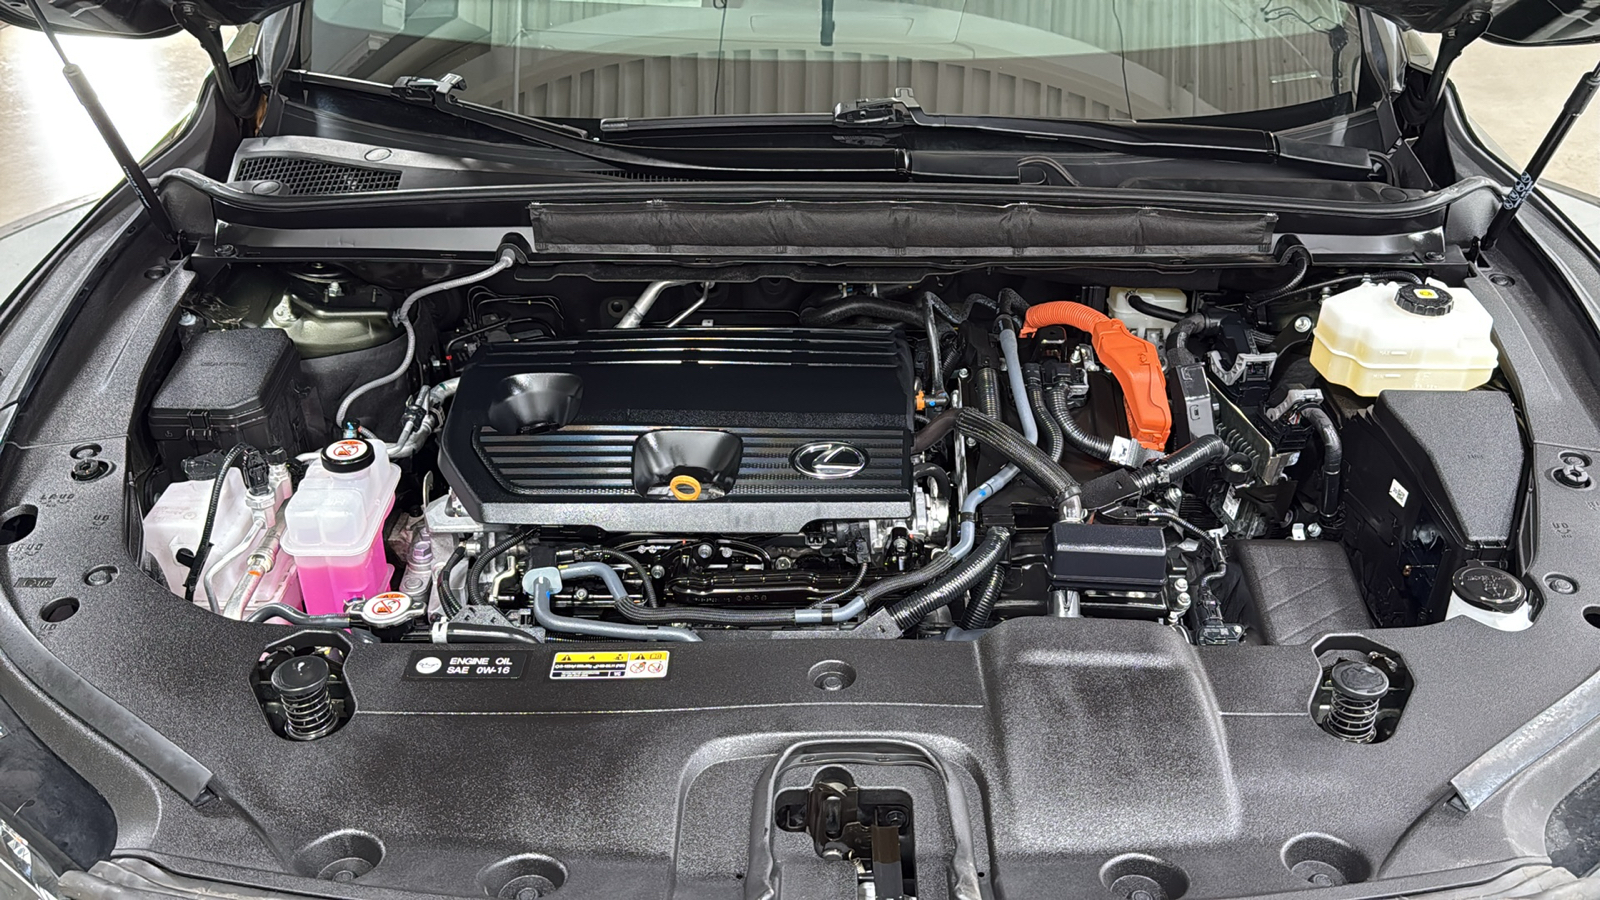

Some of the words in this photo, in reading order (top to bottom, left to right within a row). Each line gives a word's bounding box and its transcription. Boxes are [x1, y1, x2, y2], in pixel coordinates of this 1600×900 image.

[449, 657, 490, 665] ENGINE
[495, 657, 513, 665] OIL
[446, 666, 470, 674] SAE
[475, 666, 510, 674] 0W-16
